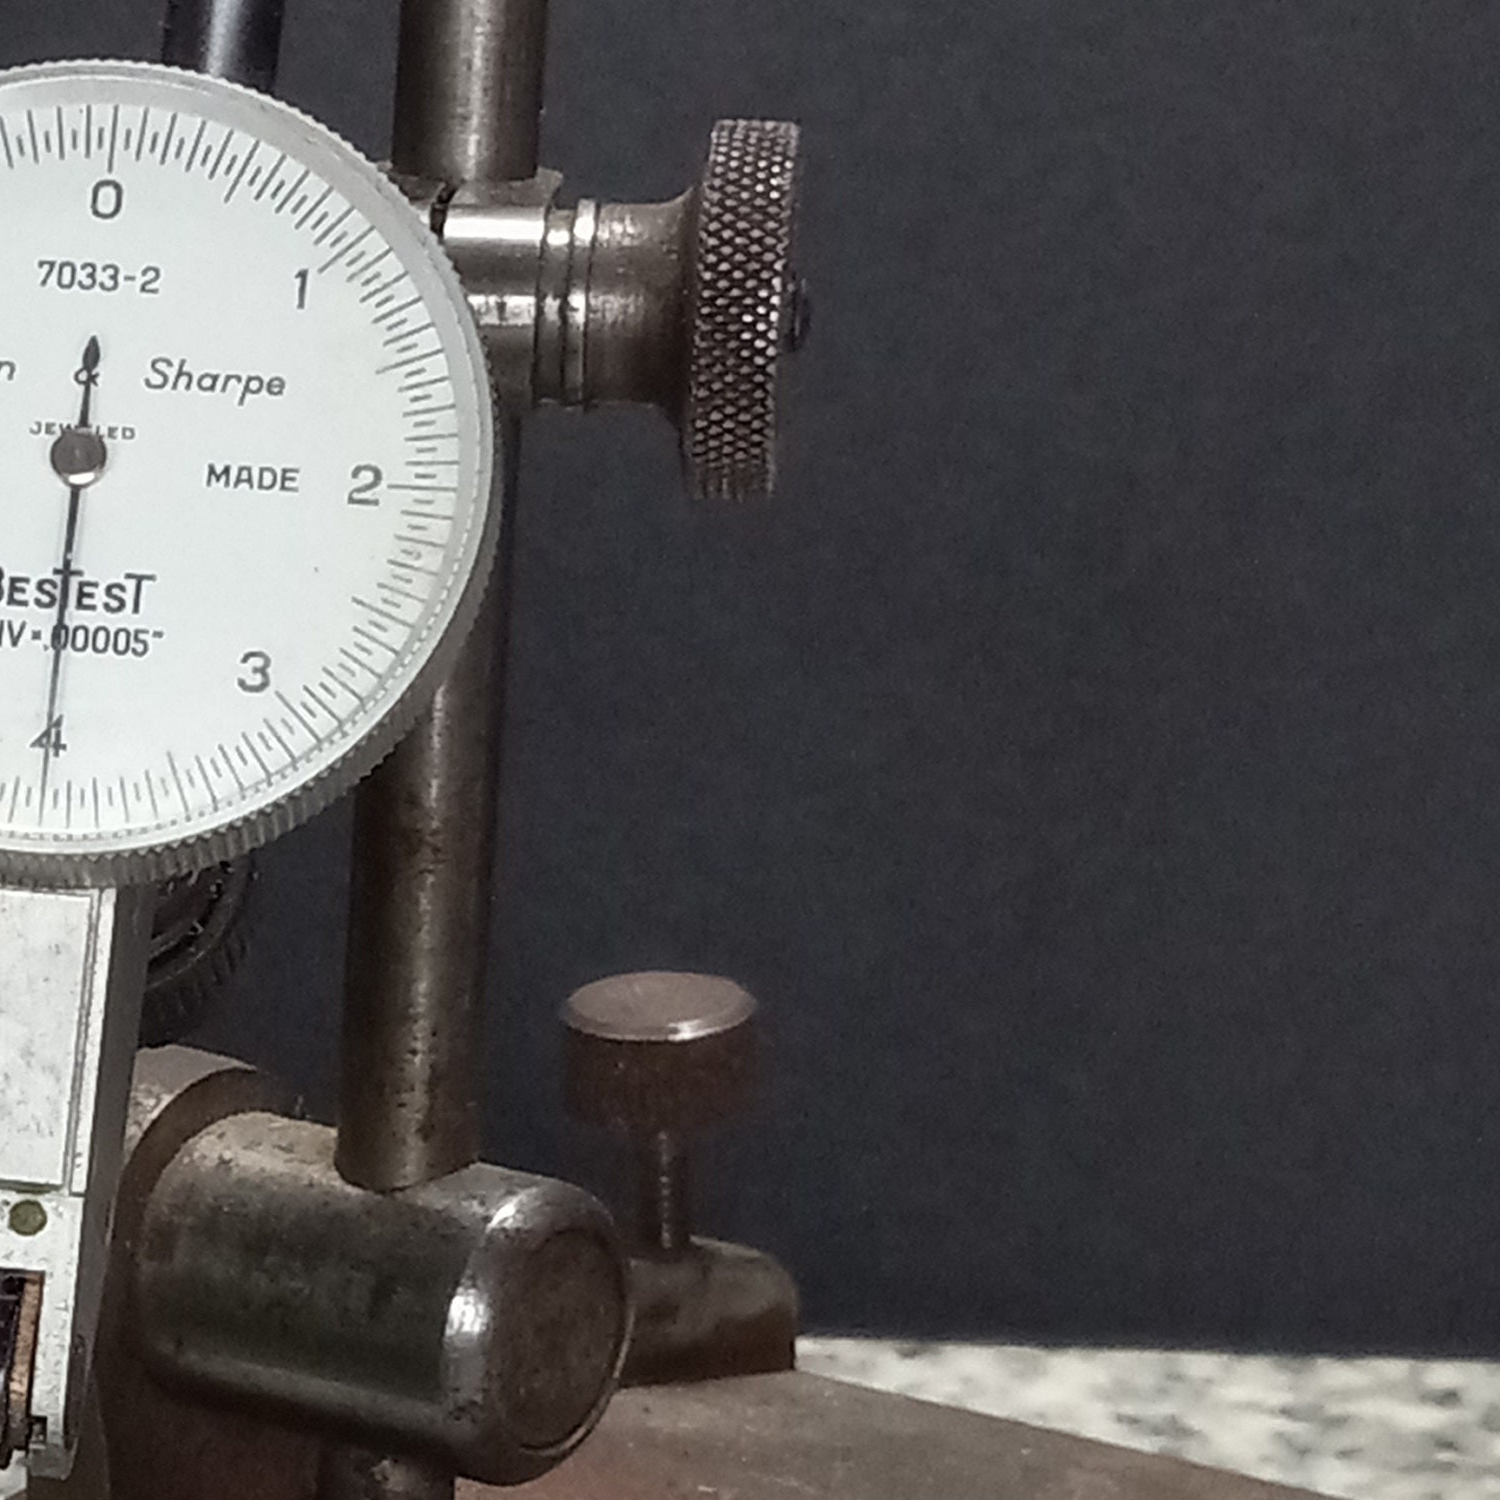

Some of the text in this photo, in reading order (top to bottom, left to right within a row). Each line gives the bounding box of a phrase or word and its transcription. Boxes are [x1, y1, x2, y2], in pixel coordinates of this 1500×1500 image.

[90, 179, 124, 220] 0
[37, 260, 162, 295] 7033-2
[294, 268, 309, 309] 1
[144, 357, 287, 406] Sharpe
[206, 463, 301, 493] MADE
[347, 464, 384, 507] 2
[237, 651, 272, 693] 3
[29, 713, 68, 757] 4
